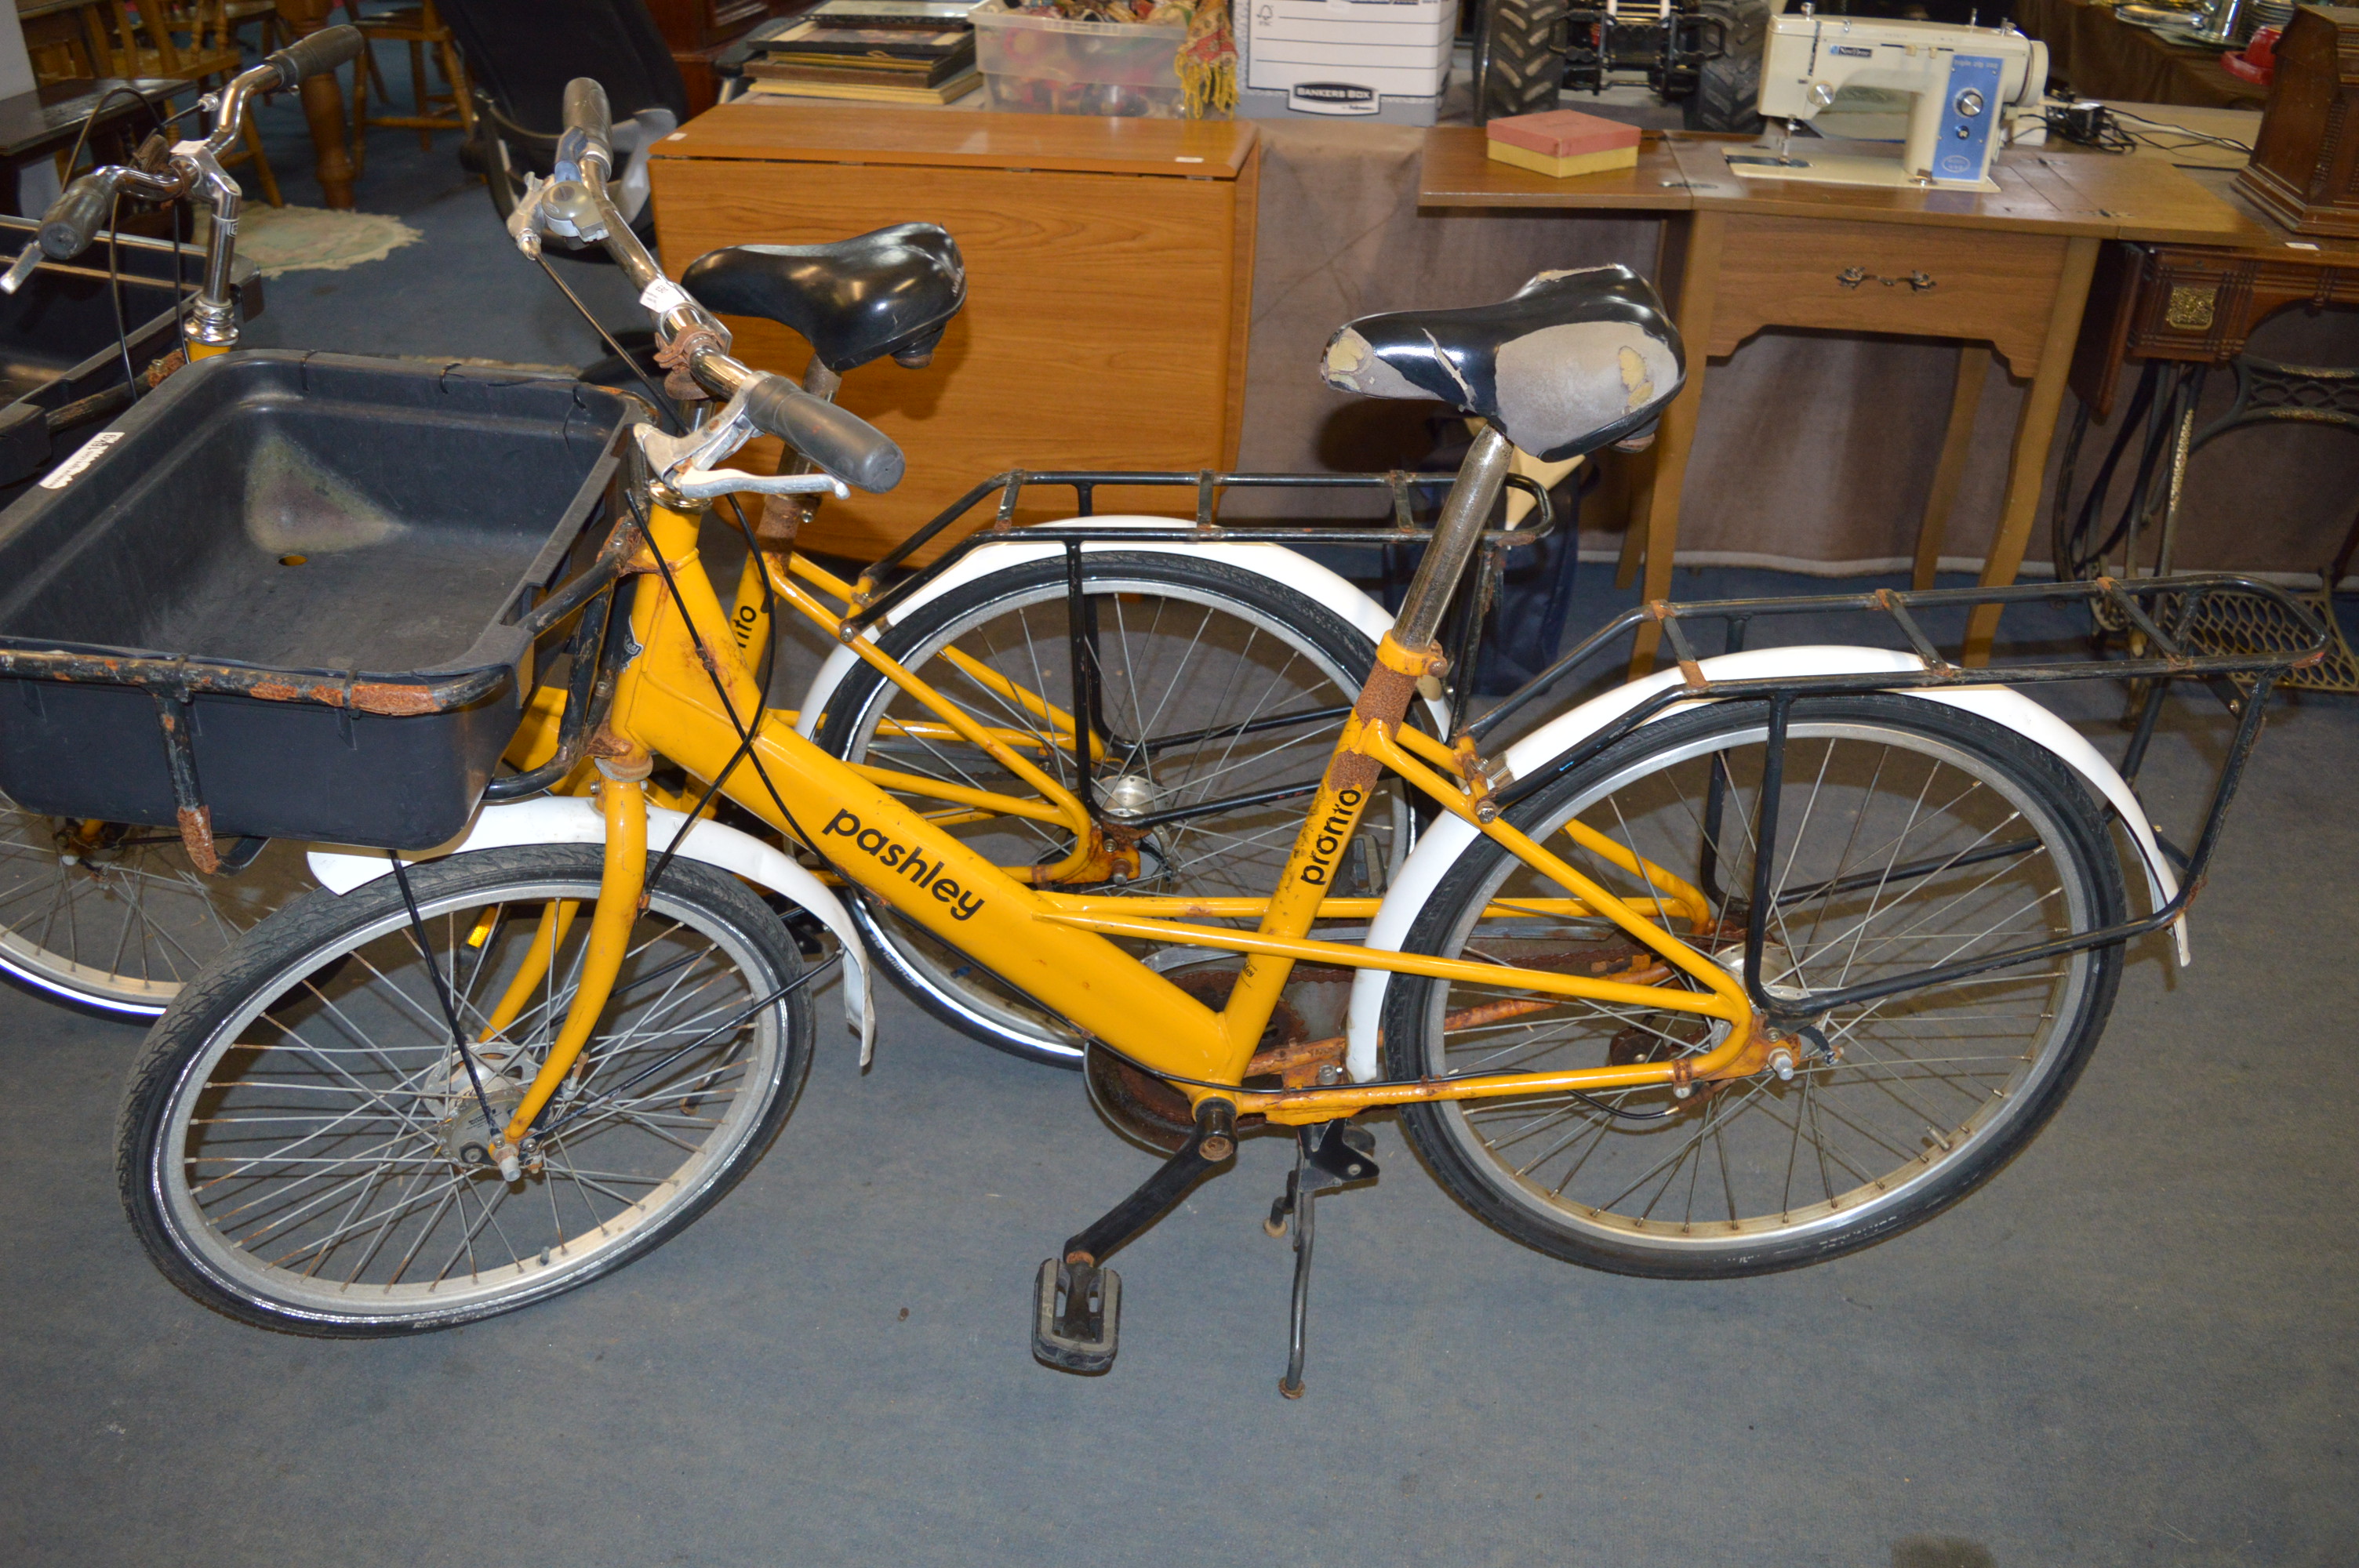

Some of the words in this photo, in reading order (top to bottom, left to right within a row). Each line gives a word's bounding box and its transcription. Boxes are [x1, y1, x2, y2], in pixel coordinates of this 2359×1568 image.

[1296, 87, 1346, 99] BANKERS
[1347, 89, 1371, 100] BOX
[821, 808, 985, 921] pashley
[1300, 789, 1361, 886] pronto
